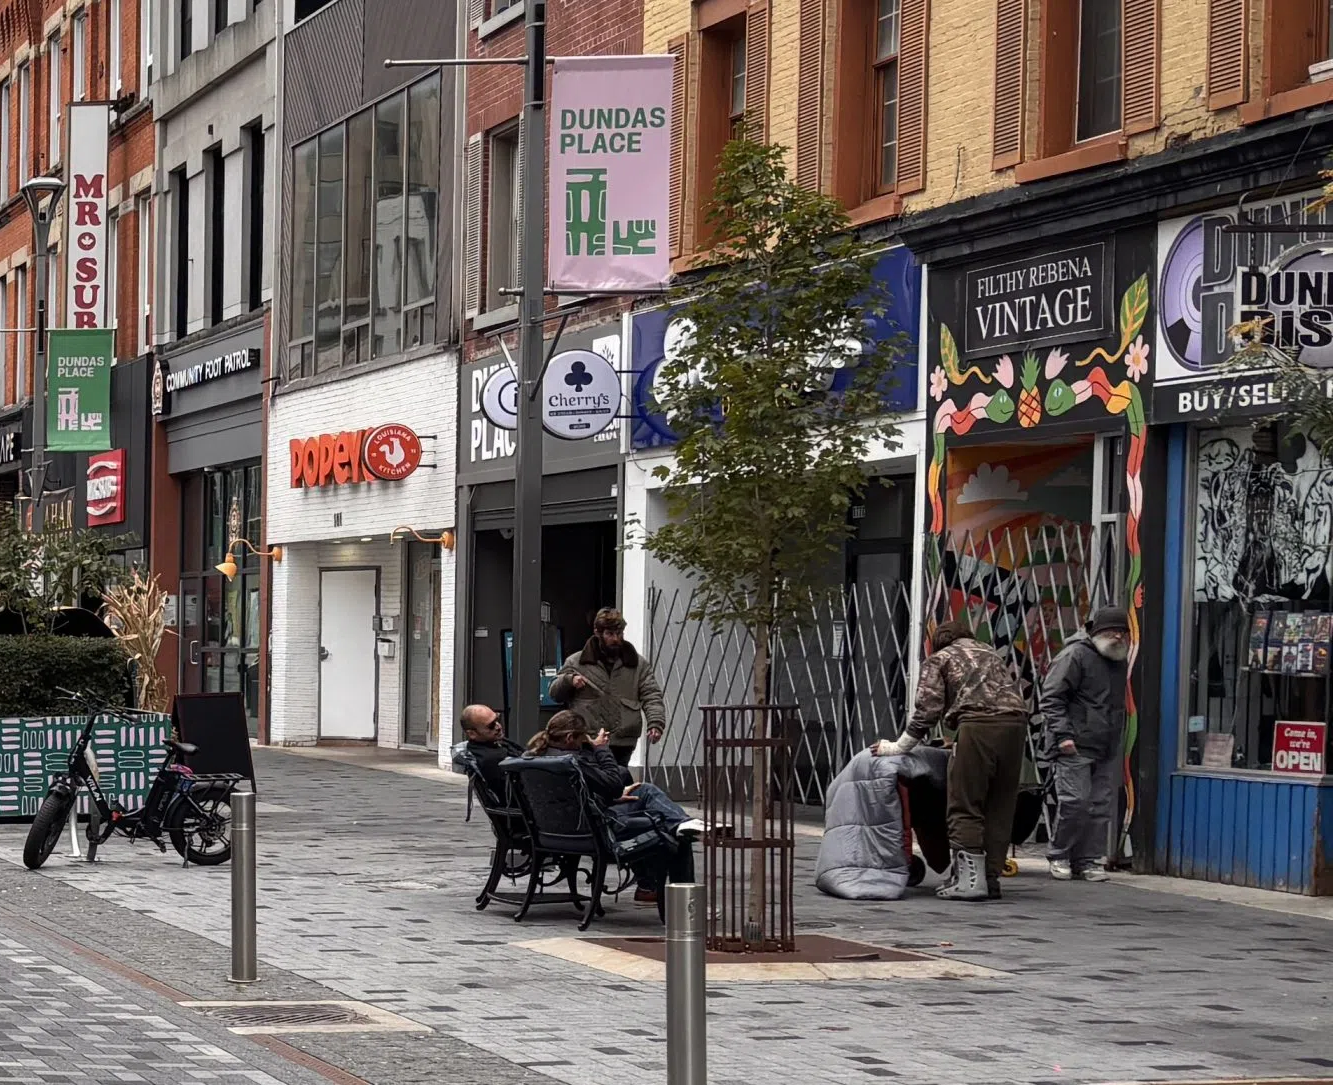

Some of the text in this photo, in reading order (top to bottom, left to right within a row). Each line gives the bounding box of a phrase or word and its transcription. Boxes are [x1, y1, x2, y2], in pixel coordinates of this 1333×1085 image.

[560, 107, 666, 130] DUNDAS
[560, 132, 643, 154] PLACE
[977, 256, 1092, 298] FILTHY REBENA
[1240, 271, 1333, 306] DUN
[975, 285, 1093, 340] VINTAGE
[57, 356, 105, 367] DUNDAS
[57, 367, 95, 377] PLACE
[166, 347, 251, 392] COMMUNITY FOOT PATROL
[548, 393, 610, 409] Cherry's
[470, 418, 517, 463] PLAC
[1284, 727, 1306, 739] Come
[1275, 749, 1322, 772] OPEN
